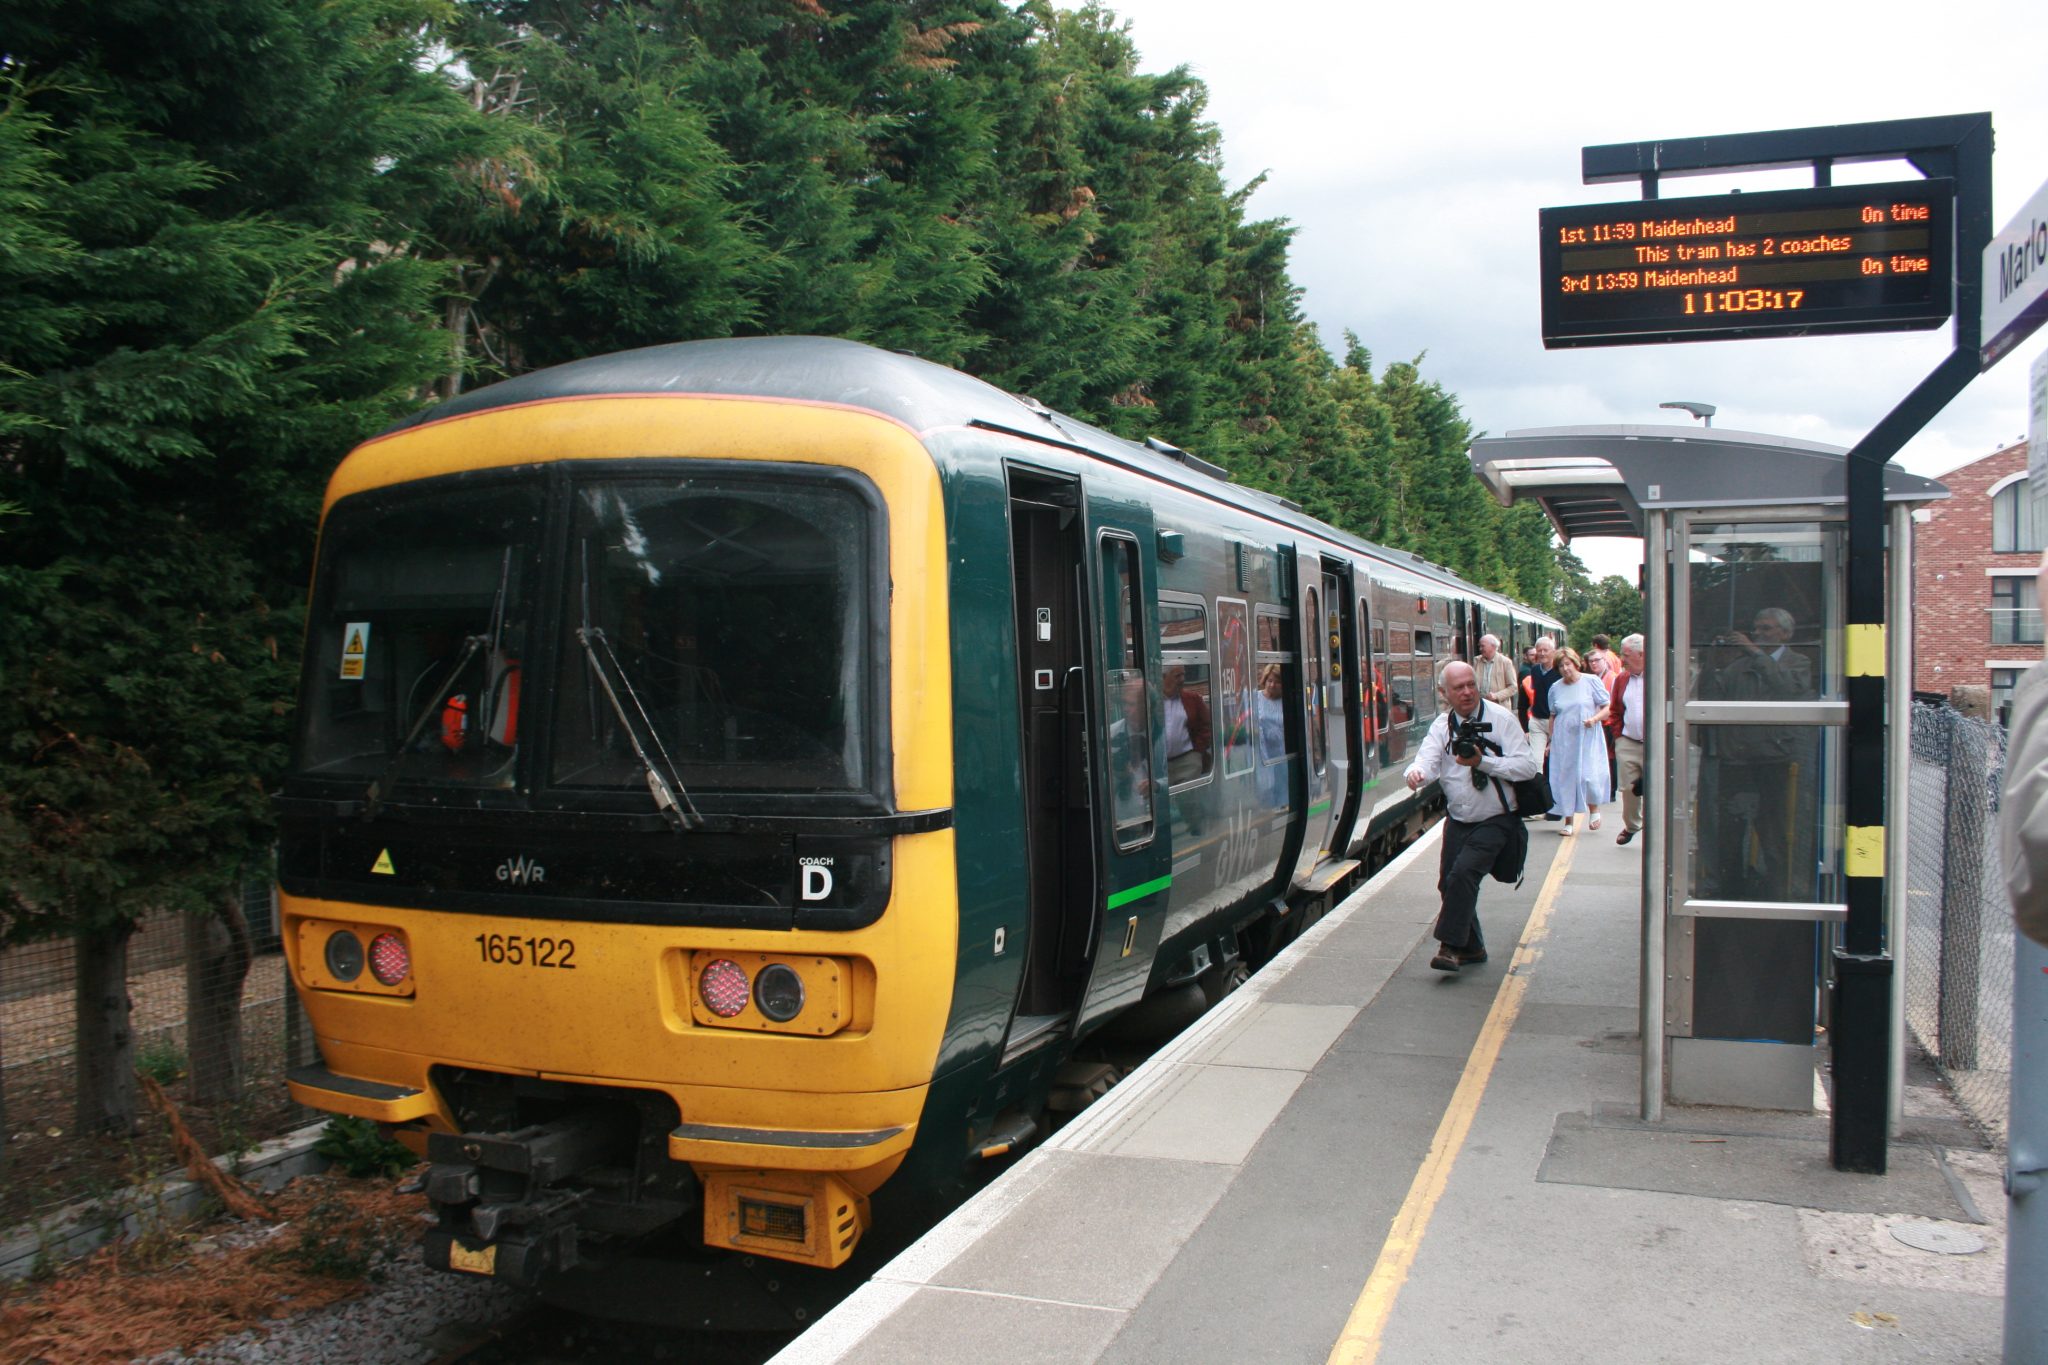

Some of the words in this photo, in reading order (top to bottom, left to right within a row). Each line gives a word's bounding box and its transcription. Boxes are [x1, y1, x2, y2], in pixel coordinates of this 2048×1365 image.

[1560, 227, 1587, 244] 1st
[1593, 222, 1635, 241] 11:59
[1642, 216, 1735, 238] Maidenhead
[1862, 206, 1884, 223] On
[1890, 203, 1929, 221] time
[1636, 246, 1669, 263] This
[1677, 244, 1719, 261] train
[1726, 241, 1757, 257] has
[1763, 238, 1774, 255] 2
[1780, 235, 1851, 254] coaches
[1561, 275, 1589, 292] 3rd
[1596, 272, 1638, 290] 13:59
[1645, 266, 1738, 287] Maidenhead
[1861, 258, 1883, 275] On
[1890, 256, 1928, 273] time
[1684, 290, 1803, 314] 11:03:17
[799, 857, 834, 866] COACH
[1214, 799, 1259, 889] GWR
[496, 854, 545, 885] GWR
[802, 865, 833, 900] D
[475, 933, 577, 969] 165122
